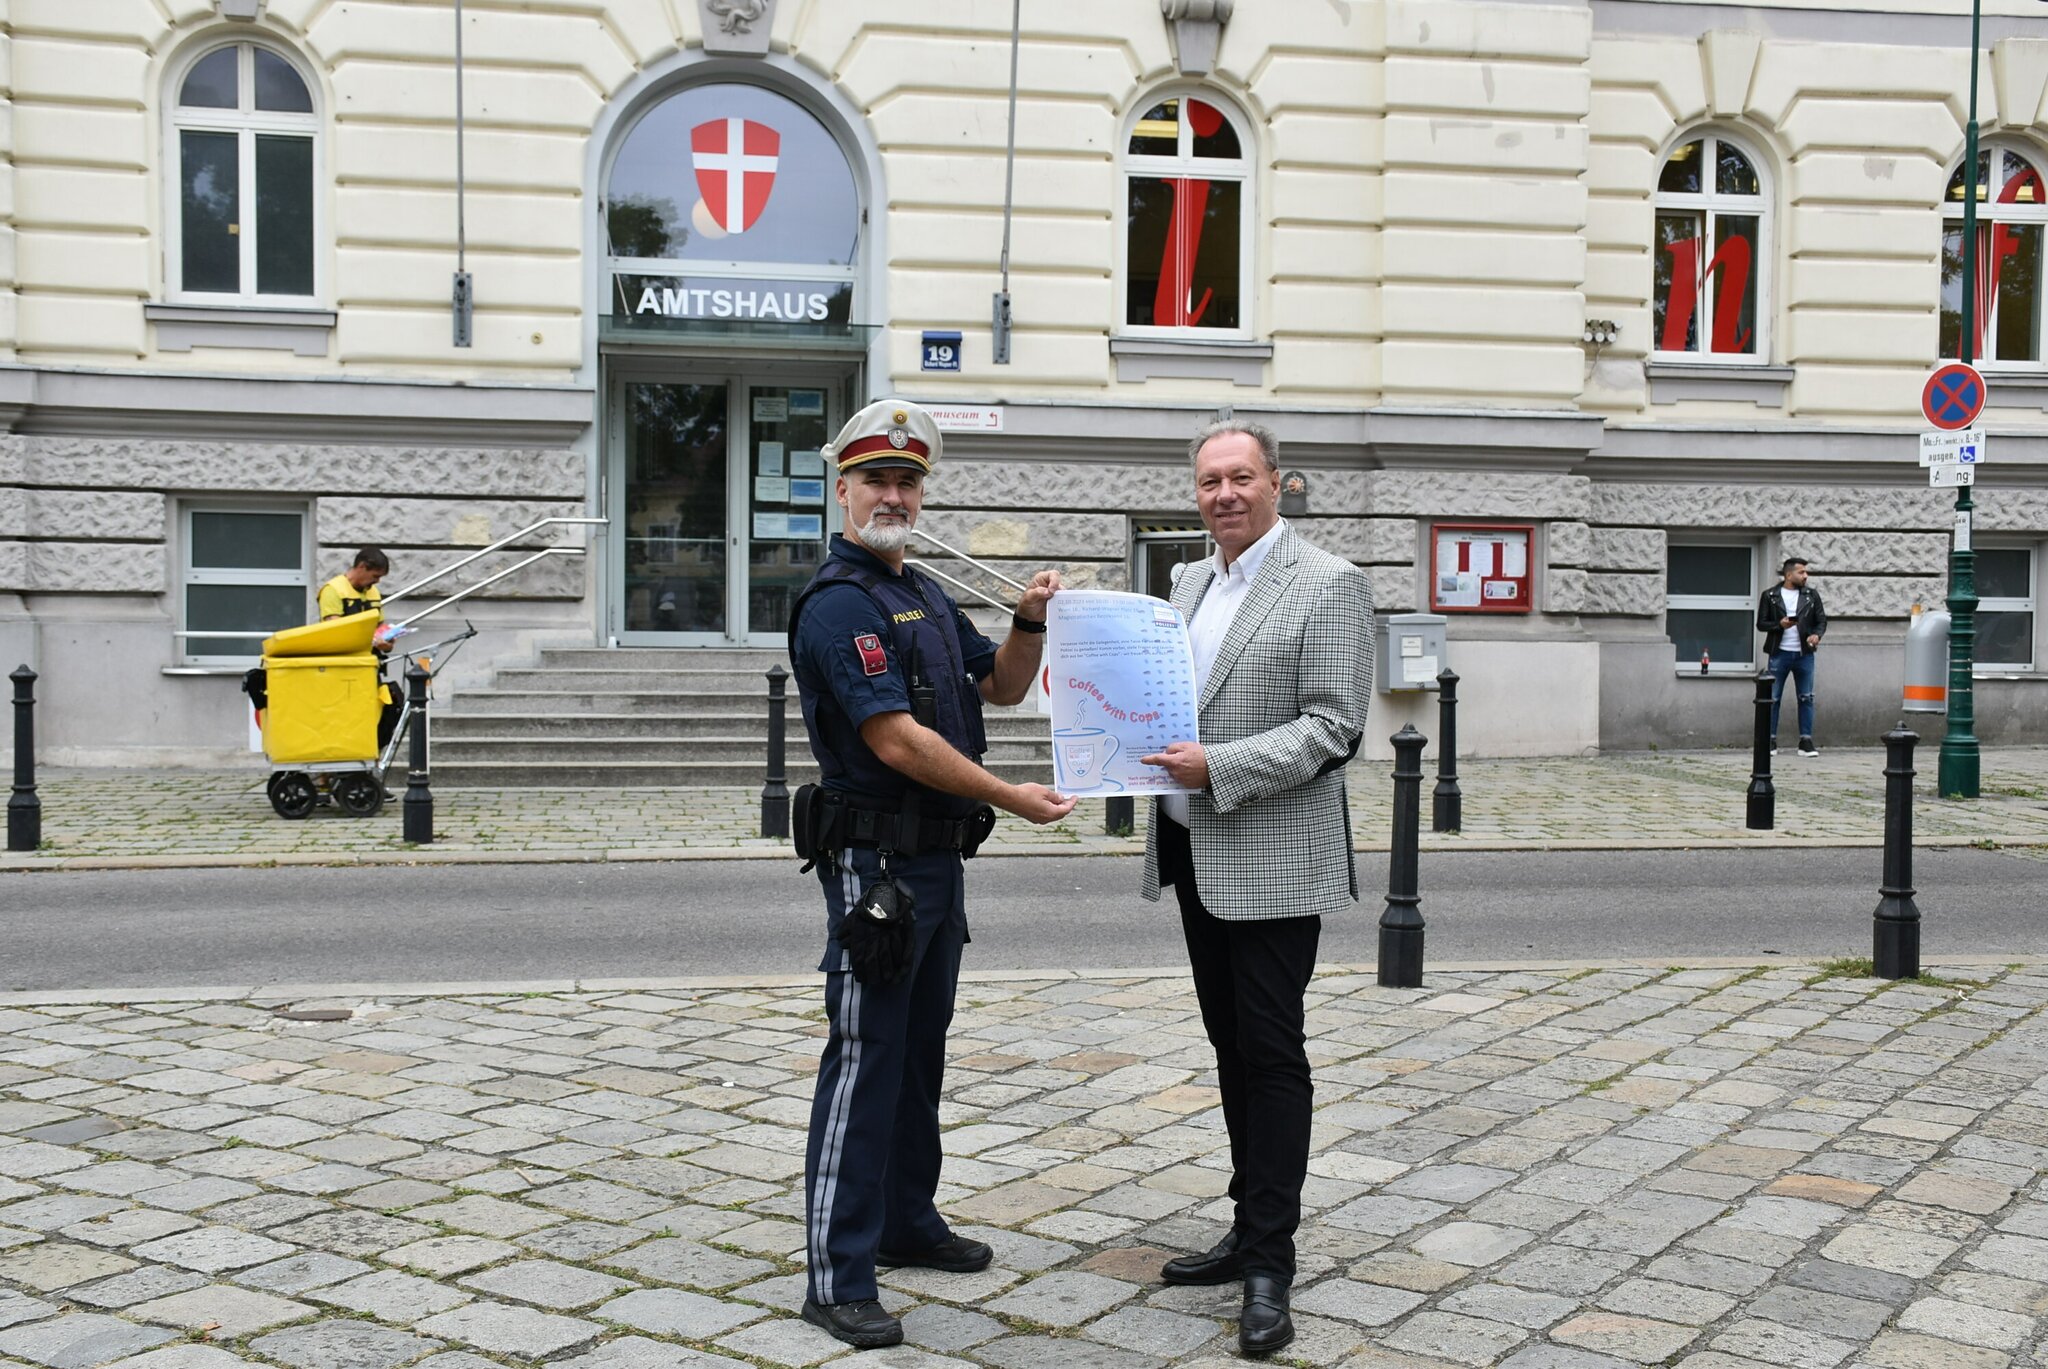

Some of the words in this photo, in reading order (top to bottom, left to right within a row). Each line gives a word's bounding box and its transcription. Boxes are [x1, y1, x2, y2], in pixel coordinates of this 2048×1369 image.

[636, 287, 829, 321] AMTSHAUS
[928, 345, 953, 361] 19
[1928, 453, 1956, 462] ausgen.
[893, 609, 925, 624] POLIZEI
[1068, 678, 1105, 701] Coffee
[1102, 701, 1126, 720] with
[1129, 711, 1160, 723] Cops
